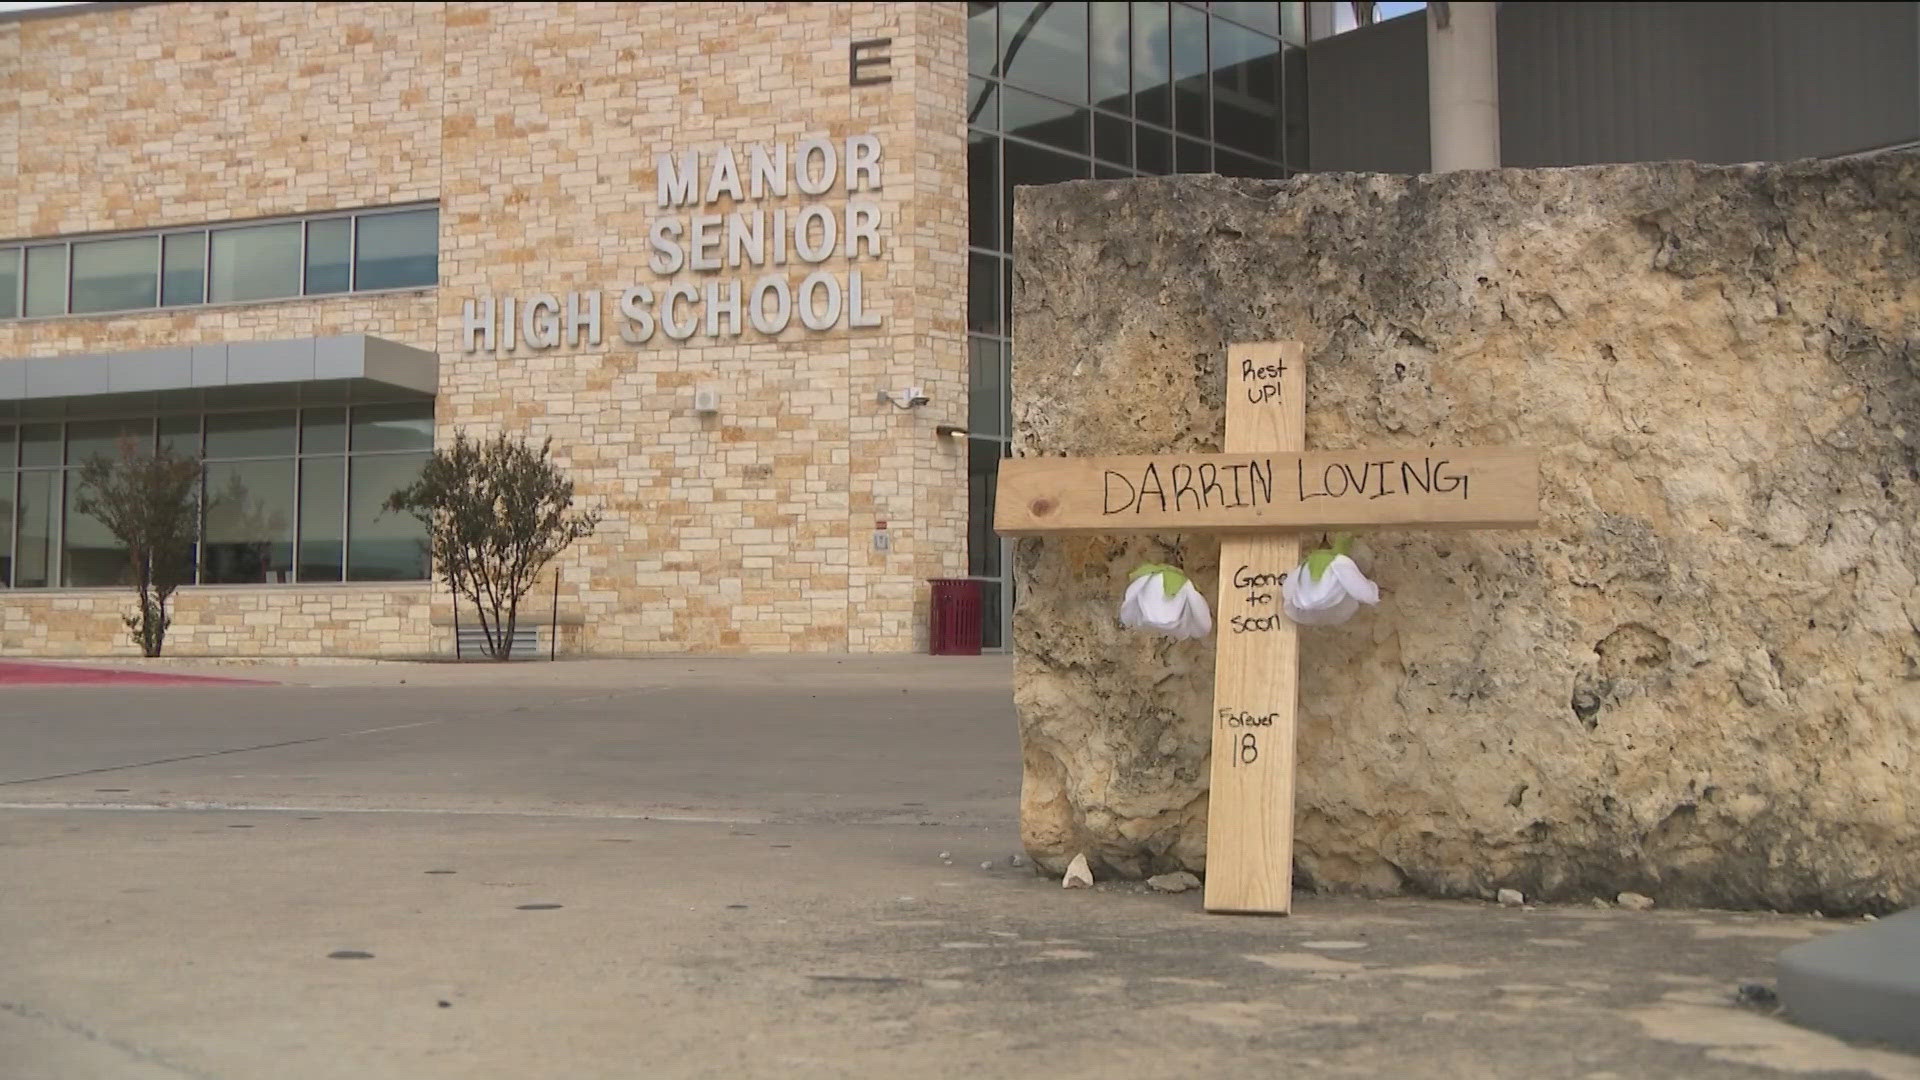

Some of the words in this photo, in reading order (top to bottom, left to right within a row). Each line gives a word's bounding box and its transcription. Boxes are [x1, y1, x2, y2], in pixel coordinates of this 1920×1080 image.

[850, 37, 892, 86] E
[657, 134, 883, 208] MANOR
[649, 200, 883, 276] SENIOR
[462, 289, 602, 353] HIGH
[619, 269, 883, 345] SCHOOL
[1242, 357, 1288, 381] Rest
[1103, 459, 1272, 515] DARRIN
[1298, 457, 1469, 502] LOVING
[1233, 565, 1288, 589] Gone
[1246, 591, 1272, 608] to
[1218, 707, 1279, 729] Forever
[1232, 732, 1258, 768] 18
